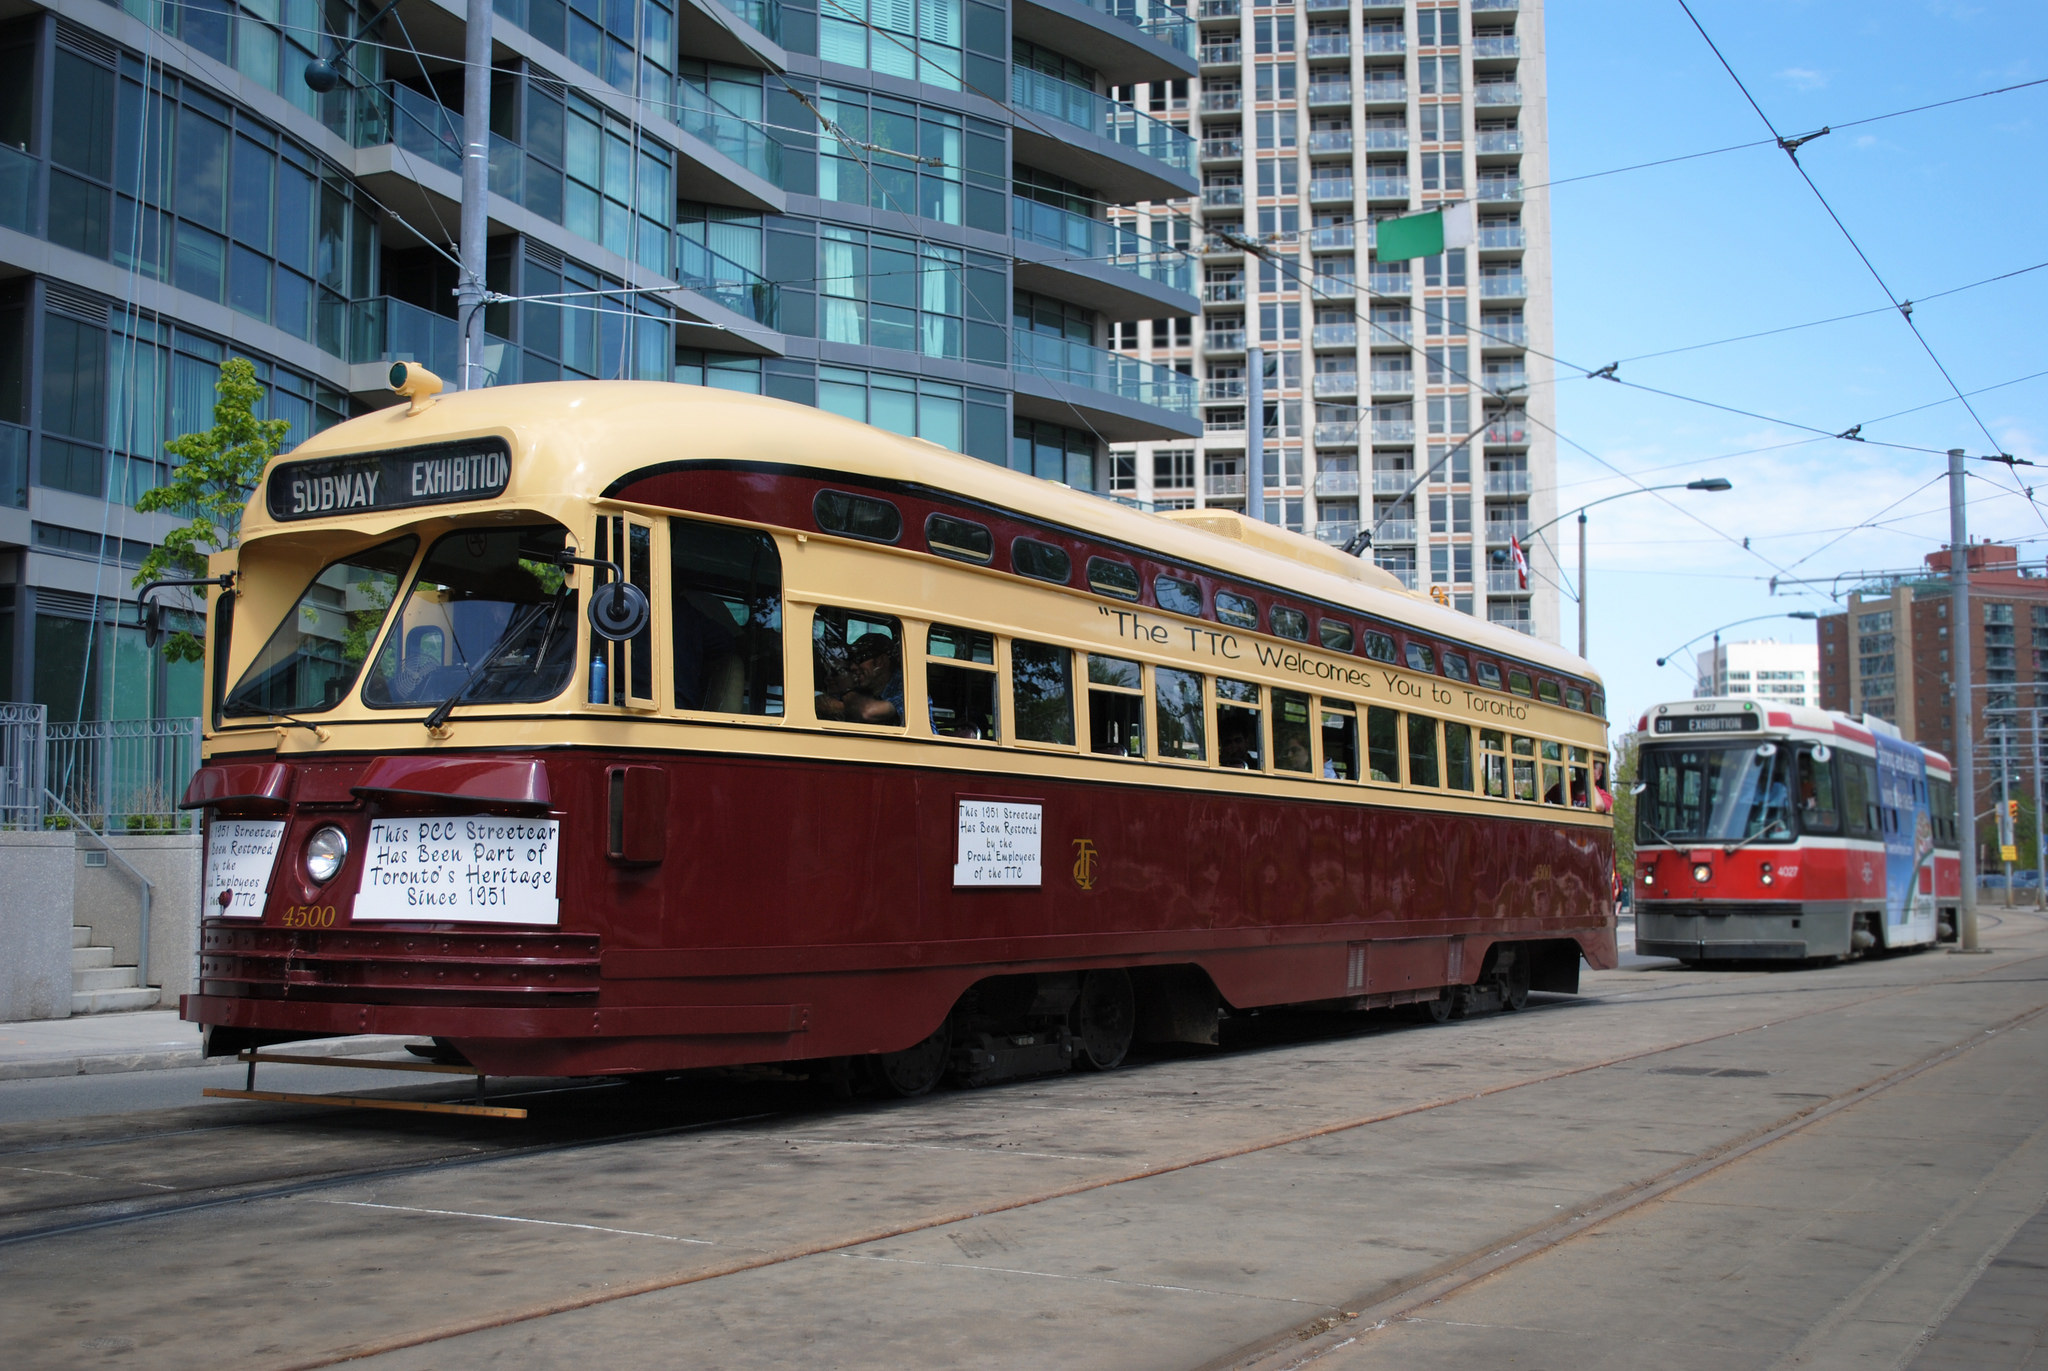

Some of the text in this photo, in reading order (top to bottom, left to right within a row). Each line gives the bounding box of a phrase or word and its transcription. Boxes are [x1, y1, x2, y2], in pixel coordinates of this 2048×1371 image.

[292, 451, 509, 514] SUBWAY EXHIBITION
[1184, 626, 1241, 659] TTC
[1254, 642, 1371, 688] Welcomes
[1382, 671, 1422, 699] You
[1432, 682, 1452, 705] to
[1694, 703, 1716, 712] 4027
[1658, 717, 1742, 732] 511 EXHIBITION
[959, 804, 1041, 820] This 1951 Streetcar
[234, 824, 283, 839] Streetcar
[372, 820, 556, 844] This PCC Streetcar
[960, 820, 1038, 836] Has Been Restored
[230, 840, 274, 857] Restored
[986, 837, 1013, 851] by the
[377, 842, 547, 866] Has Been Part of
[967, 850, 1036, 865] Proud Employees
[222, 858, 237, 871] the
[1776, 864, 1799, 878] 4027
[370, 863, 553, 889] Toronto's Heritage
[974, 866, 1023, 880] of the TTC
[216, 874, 260, 891] Employees
[235, 892, 257, 907] TTC
[407, 886, 507, 906] Since 1951
[282, 905, 336, 928] 4500
